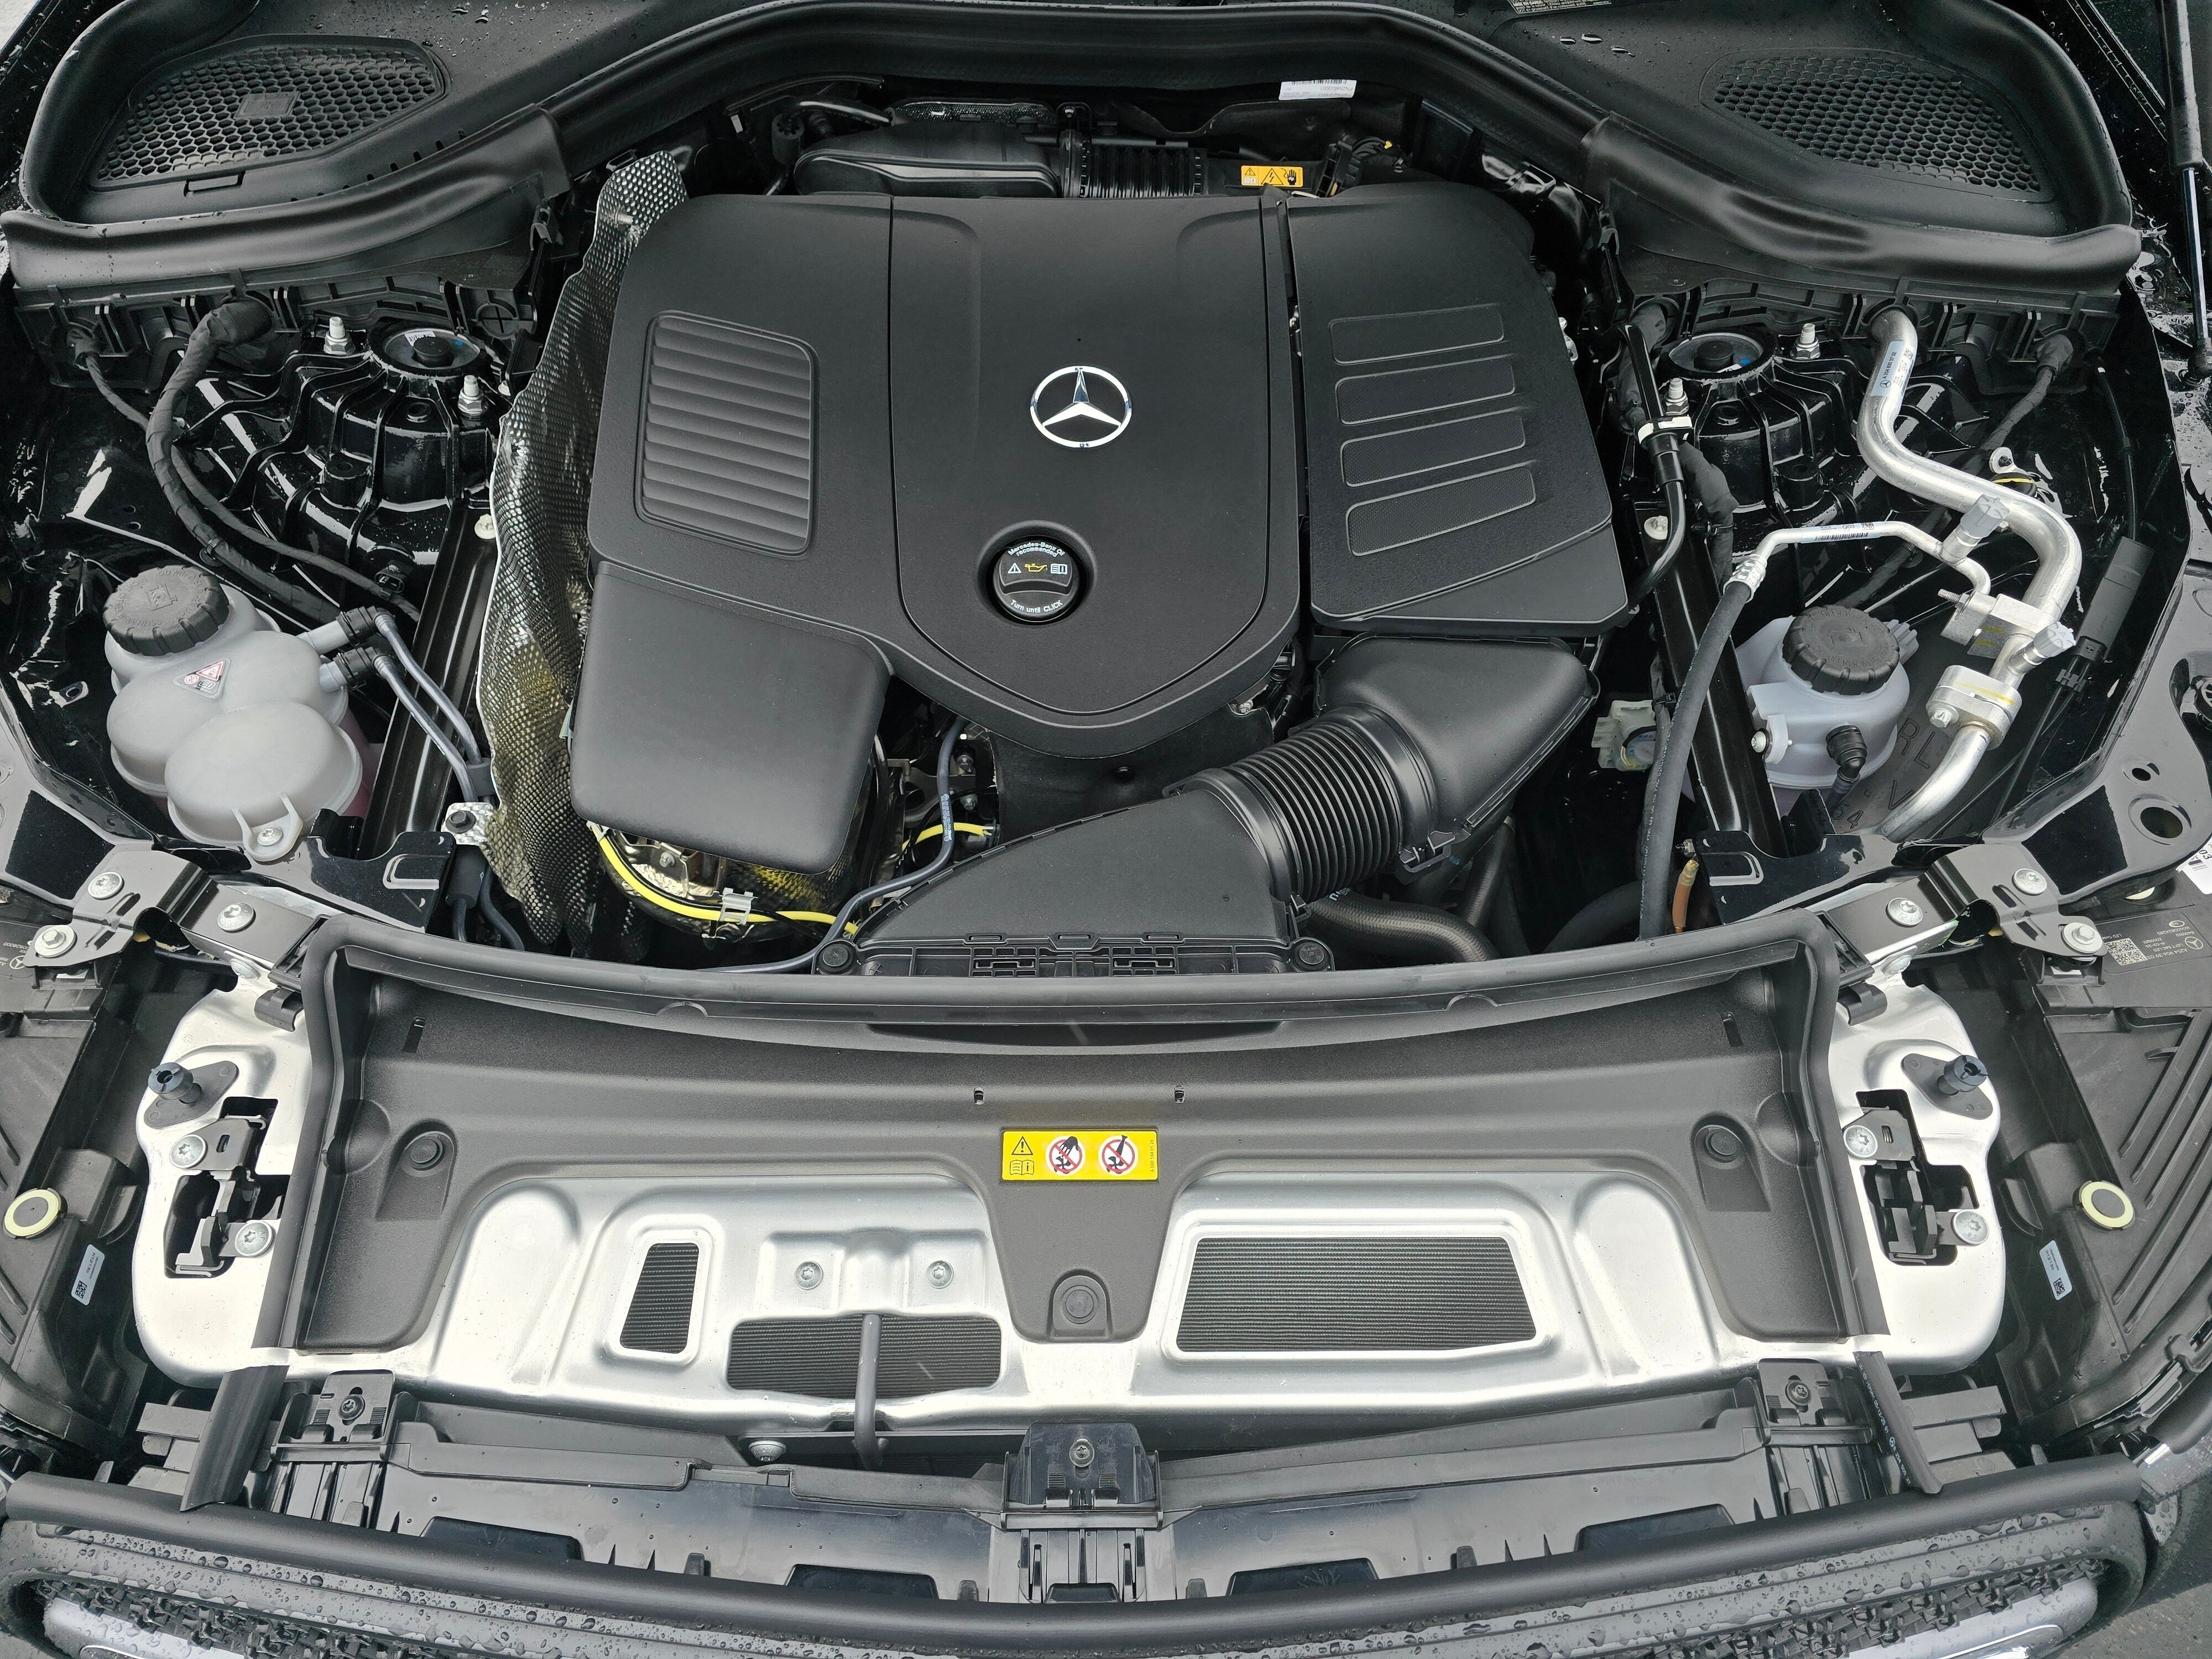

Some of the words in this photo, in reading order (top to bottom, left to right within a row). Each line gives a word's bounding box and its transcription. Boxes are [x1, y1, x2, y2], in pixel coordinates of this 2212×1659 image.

[1016, 546, 1058, 557] recommended
[1010, 599, 1025, 612] Turn
[1043, 599, 1063, 613] CLICK
[1898, 717, 1936, 769] RL
